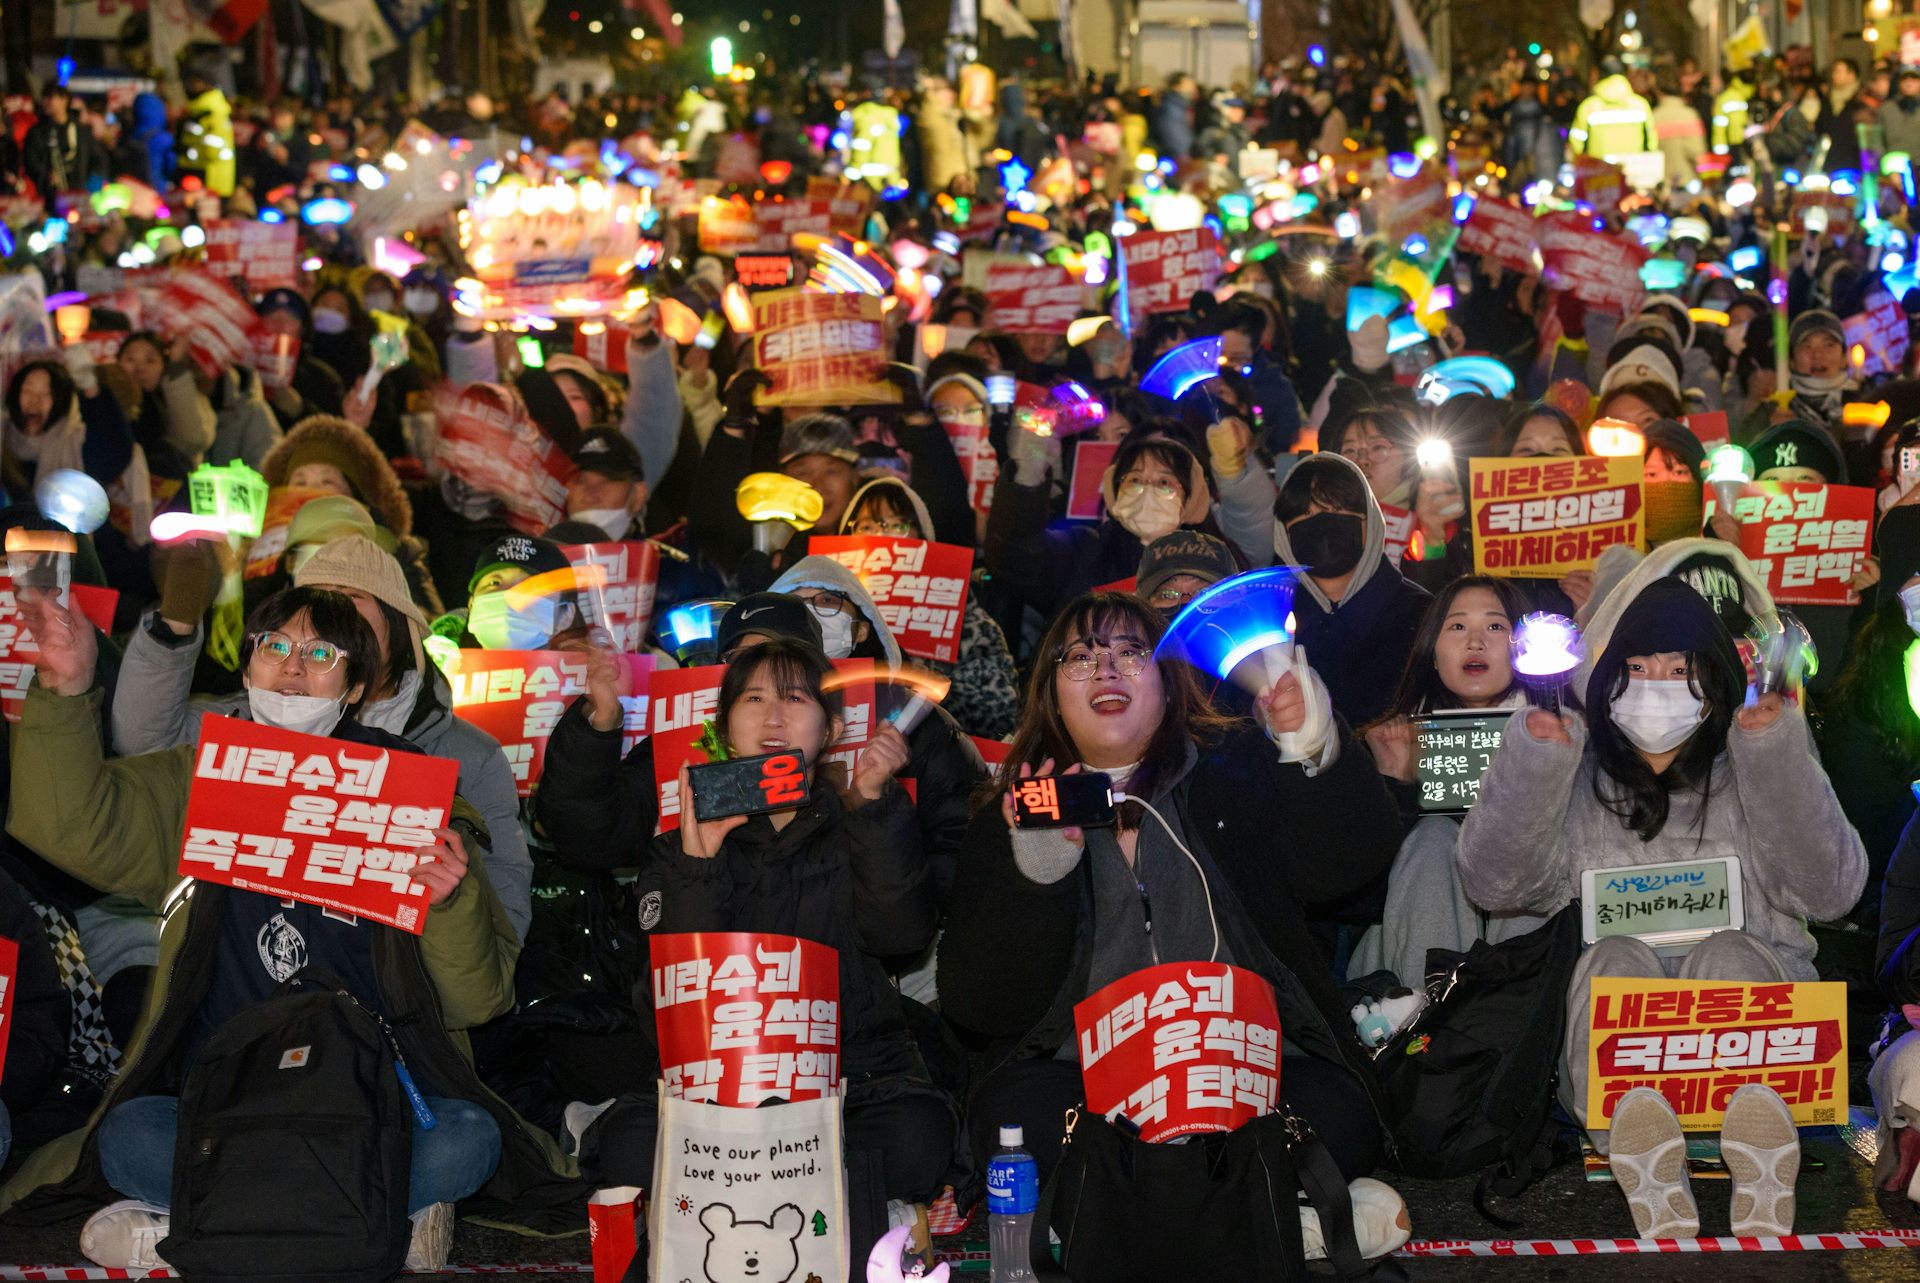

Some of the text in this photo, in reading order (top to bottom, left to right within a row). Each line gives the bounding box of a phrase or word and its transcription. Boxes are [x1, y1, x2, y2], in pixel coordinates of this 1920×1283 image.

[1473, 457, 1609, 499] 내란동조
[1489, 488, 1626, 533] 국민의힘
[1704, 484, 1828, 526] 란수괴
[826, 540, 928, 573] 란수괴
[1763, 519, 1868, 555] 윤석열
[867, 573, 965, 607] 윤석열
[878, 603, 960, 639] 탄핵!
[1418, 733, 1466, 749] 민주주의의
[195, 742, 390, 798] 내란수괴
[1418, 755, 1469, 775] 대통령은
[1012, 778, 1060, 821] 핵
[1422, 781, 1446, 801] 있을
[283, 794, 444, 848] 윤석열
[183, 827, 296, 878] 즉각
[654, 937, 802, 1010] 내란수괴
[711, 998, 837, 1050] 윤석열
[1081, 964, 1234, 1071] 내란수괴
[1593, 983, 1794, 1030] 내란동조
[1153, 1017, 1278, 1071] 윤석열
[1614, 1026, 1818, 1072] 국민의힘
[684, 1134, 819, 1161] Save our planet
[684, 1158, 821, 1187] Love your world.
